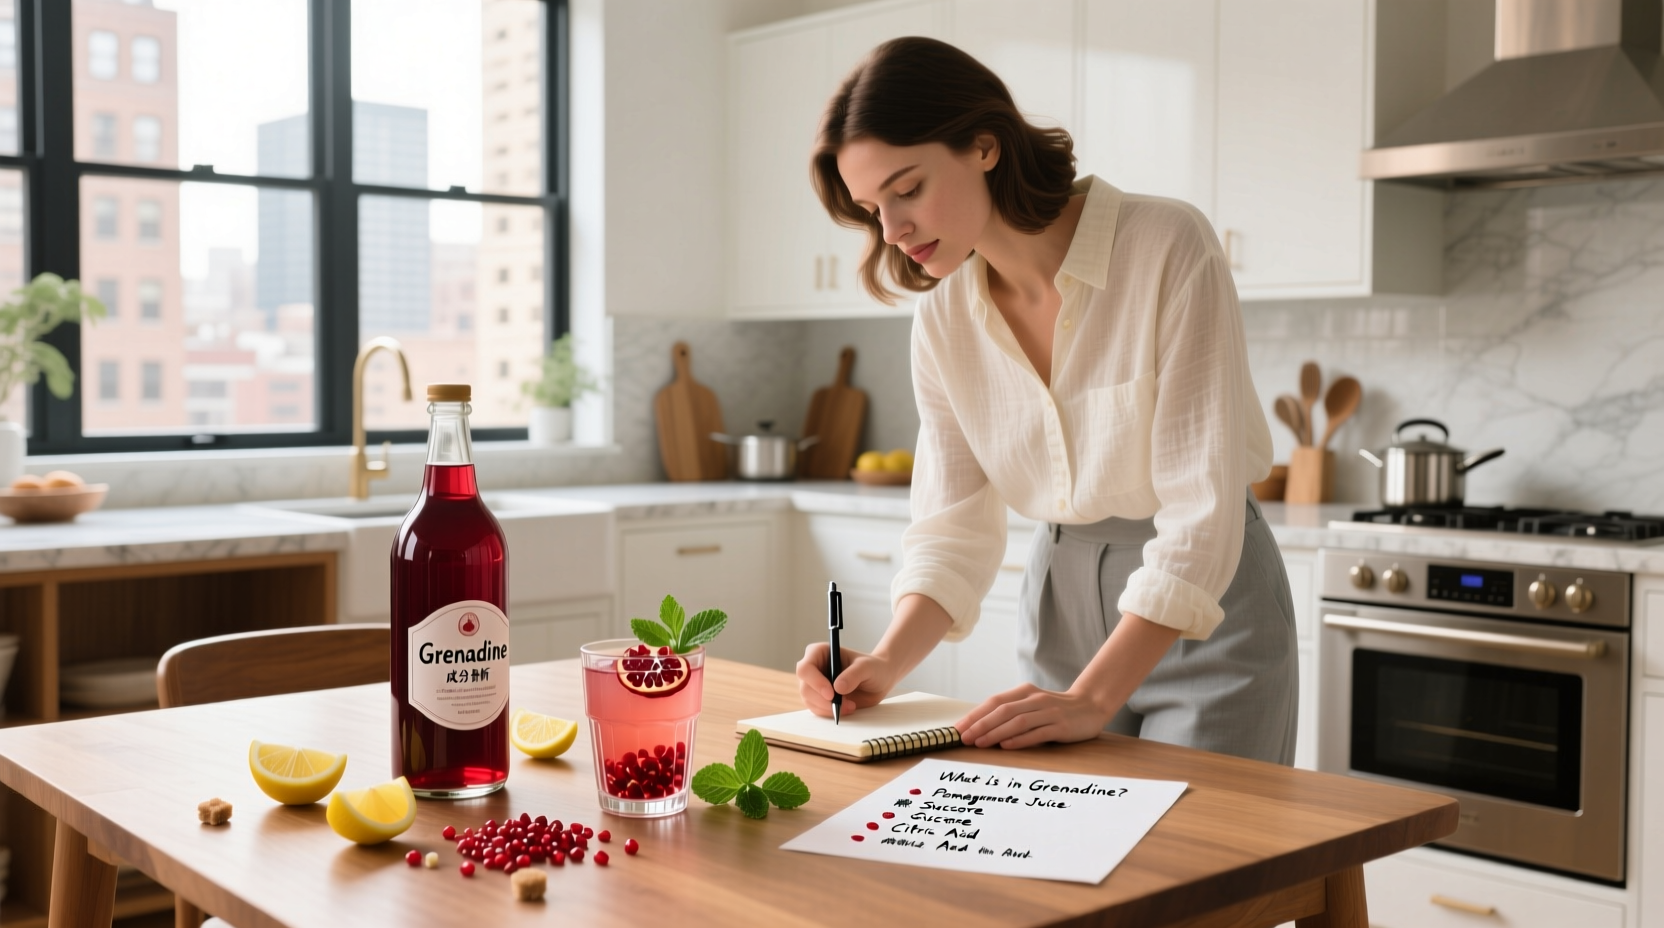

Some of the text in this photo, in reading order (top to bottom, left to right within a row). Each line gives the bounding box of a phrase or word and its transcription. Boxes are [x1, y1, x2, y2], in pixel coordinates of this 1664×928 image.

[419, 640, 507, 664] Grenadine
[939, 771, 980, 784] What
[1007, 777, 1022, 789] in
[1029, 779, 1128, 798] Grenadine?
[1025, 797, 1069, 809] Juice
